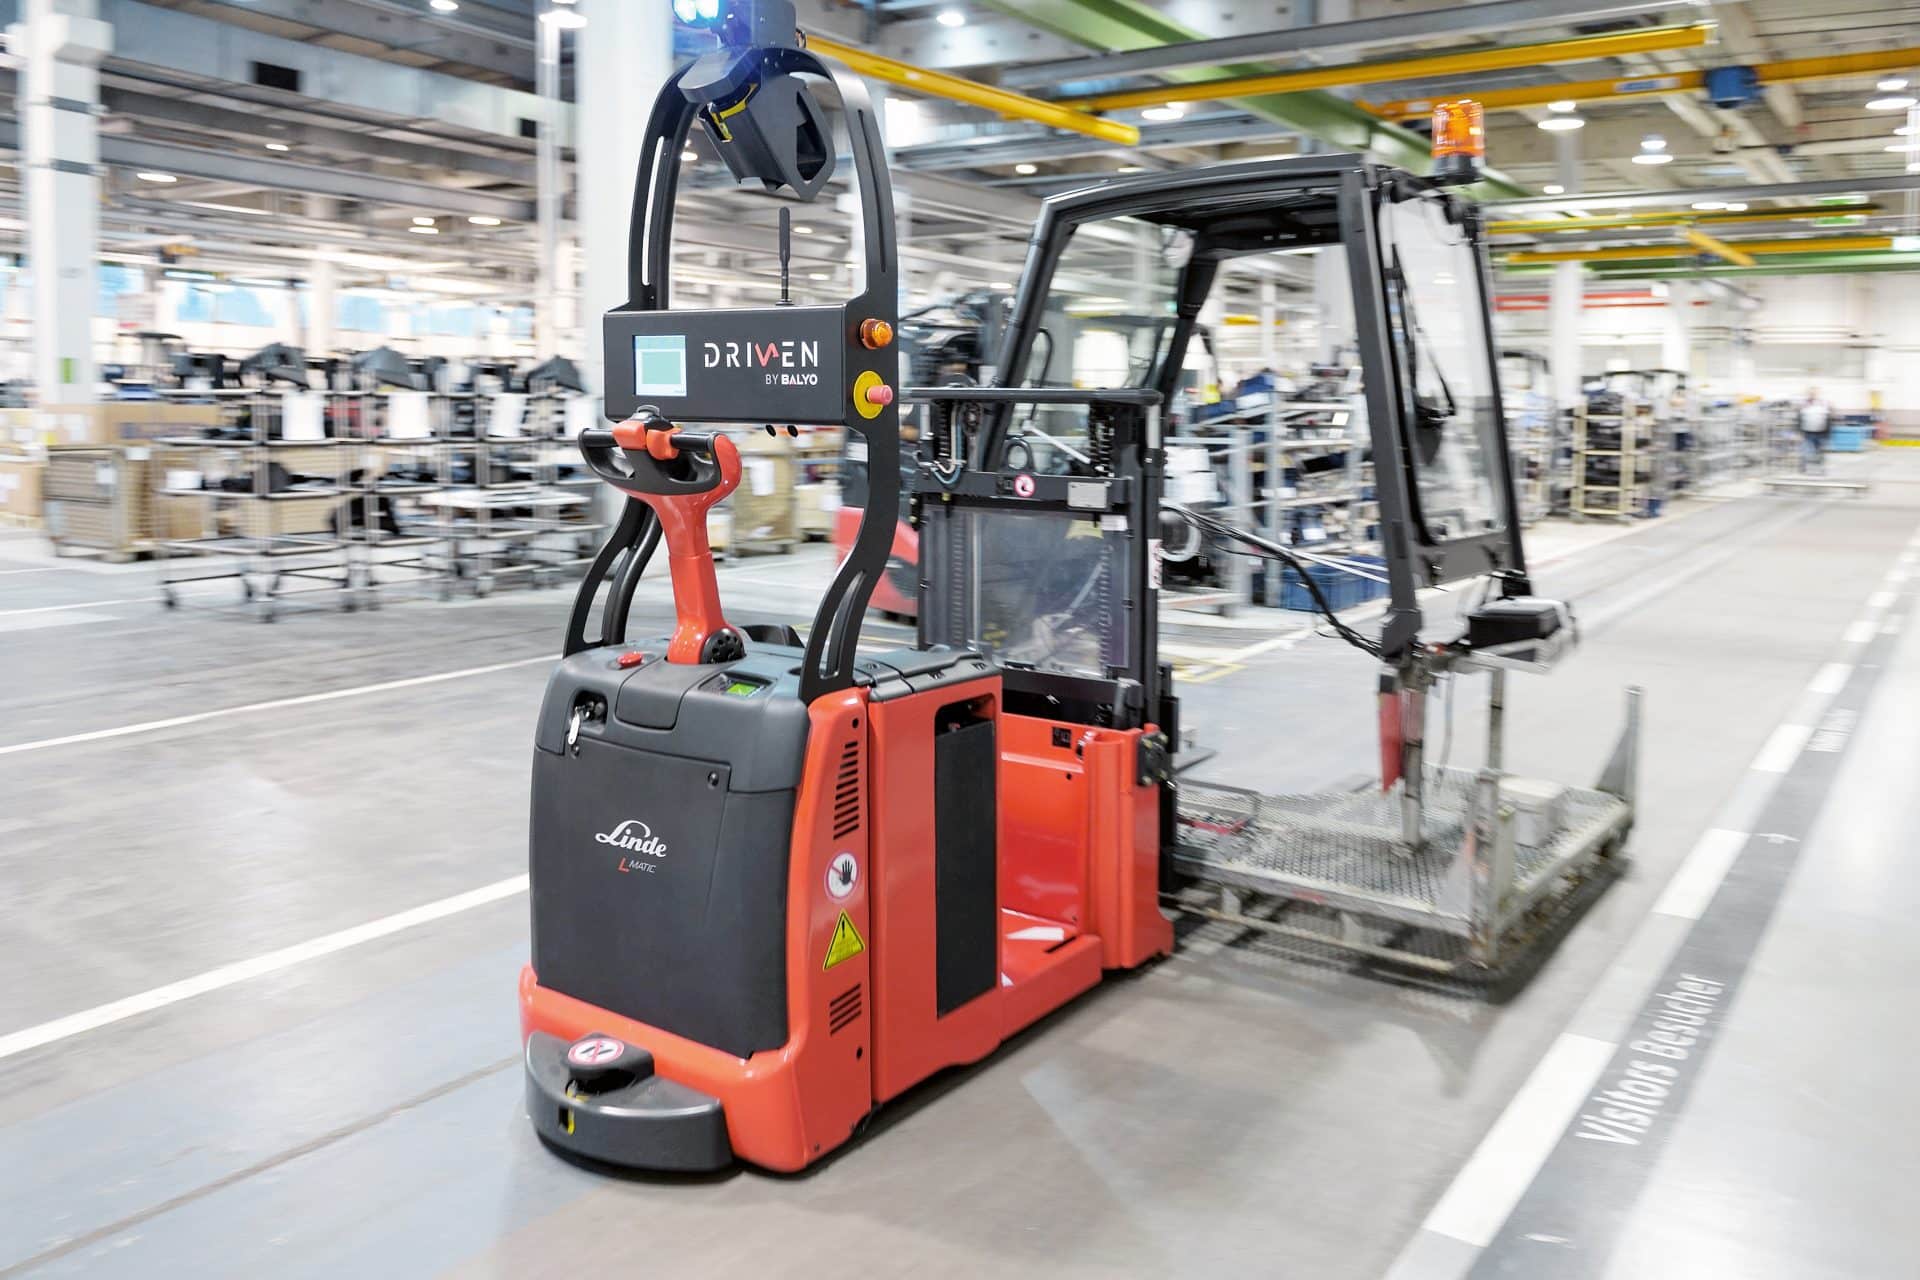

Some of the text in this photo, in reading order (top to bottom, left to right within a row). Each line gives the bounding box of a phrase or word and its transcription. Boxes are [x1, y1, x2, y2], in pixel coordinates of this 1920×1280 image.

[704, 341, 818, 368] DRIVEN
[765, 374, 818, 386] BY BALYO
[595, 820, 667, 857] Linde
[629, 860, 657, 874] MATIC
[1574, 972, 1726, 1146] Visitors Besucher
